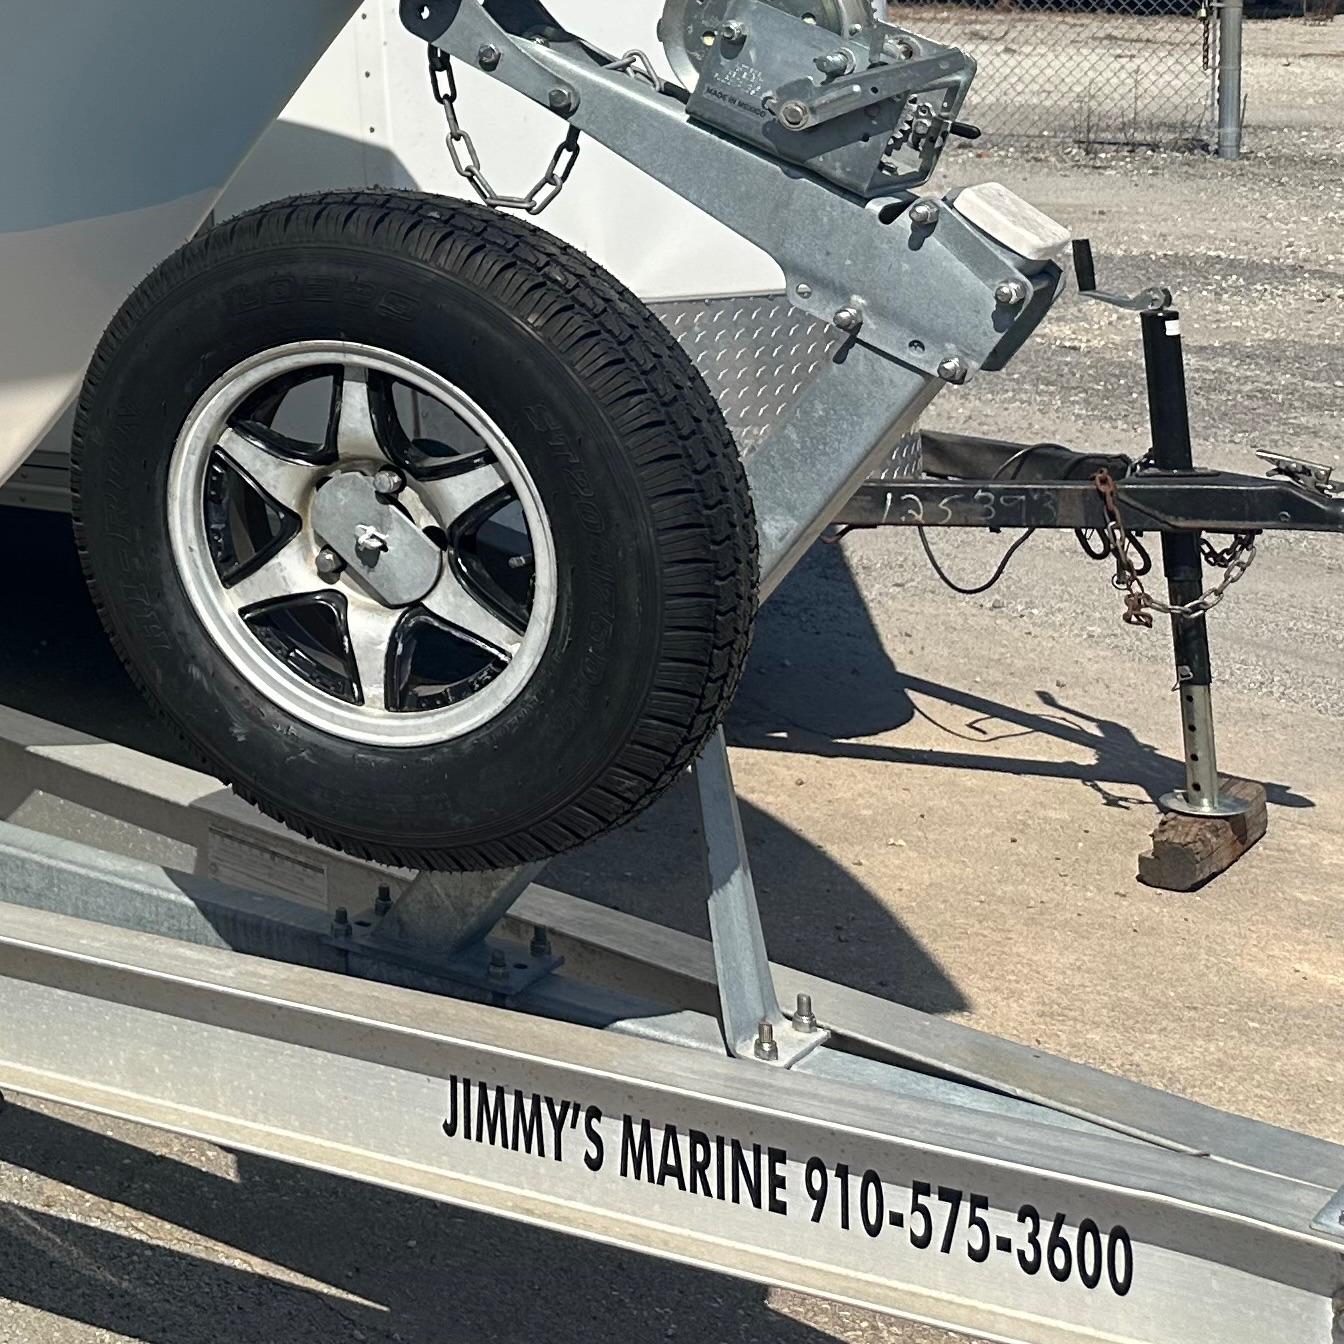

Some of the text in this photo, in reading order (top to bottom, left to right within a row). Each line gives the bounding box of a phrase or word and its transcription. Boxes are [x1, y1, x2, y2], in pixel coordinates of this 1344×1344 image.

[442, 1074, 1134, 1297] JIMMY'S MARINE 910-575-3600
